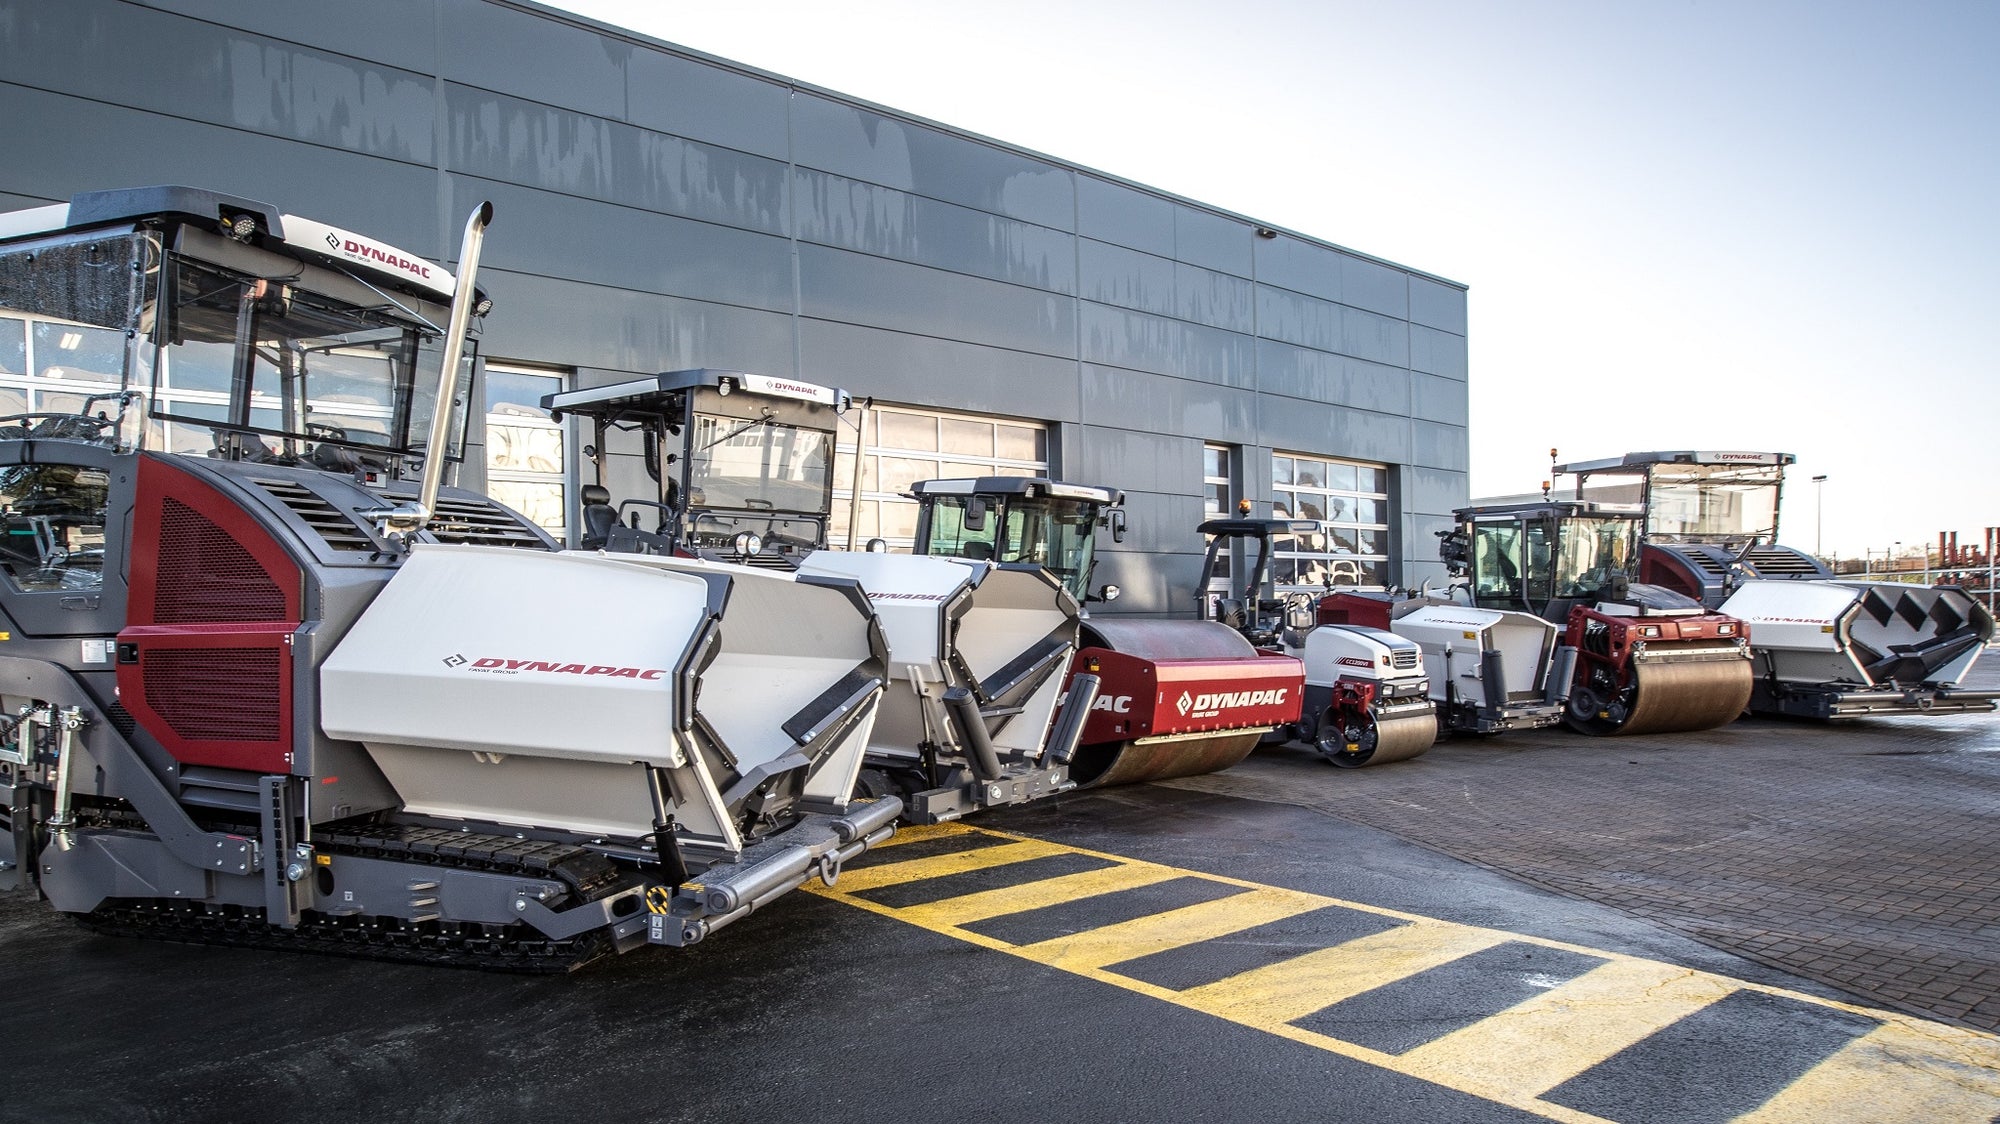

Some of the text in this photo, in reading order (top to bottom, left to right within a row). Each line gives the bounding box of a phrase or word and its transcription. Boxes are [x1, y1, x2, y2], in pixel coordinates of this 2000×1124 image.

[344, 239, 430, 279] DYNAPAC
[774, 382, 818, 396] DYNAPAC
[471, 657, 668, 680] DYNAPAC
[1192, 688, 1288, 711] DYNAPAC
